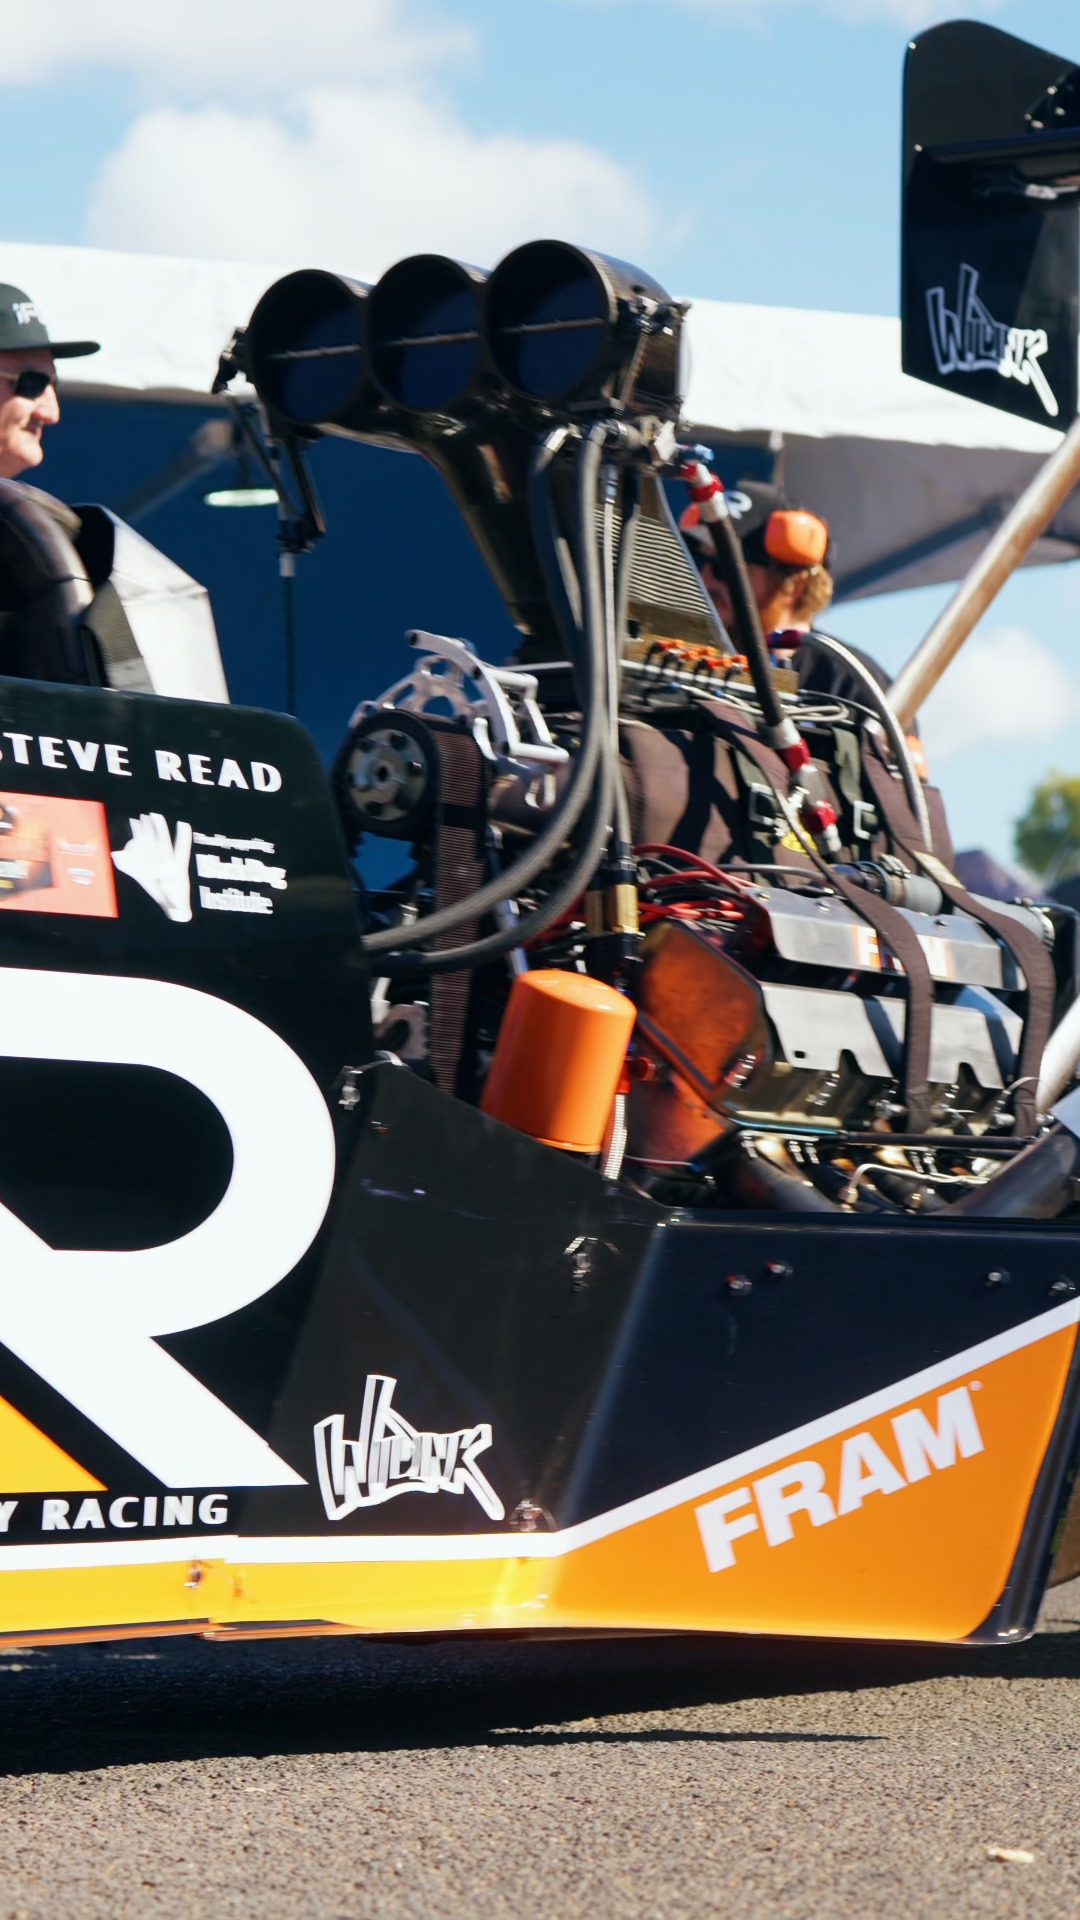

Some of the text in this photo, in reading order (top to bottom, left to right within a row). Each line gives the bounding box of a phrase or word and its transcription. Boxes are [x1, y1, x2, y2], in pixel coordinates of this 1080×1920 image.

[0, 732, 282, 793] TEVE READ
[694, 1386, 985, 1573] FRAM
[41, 1493, 228, 1531] RACING
